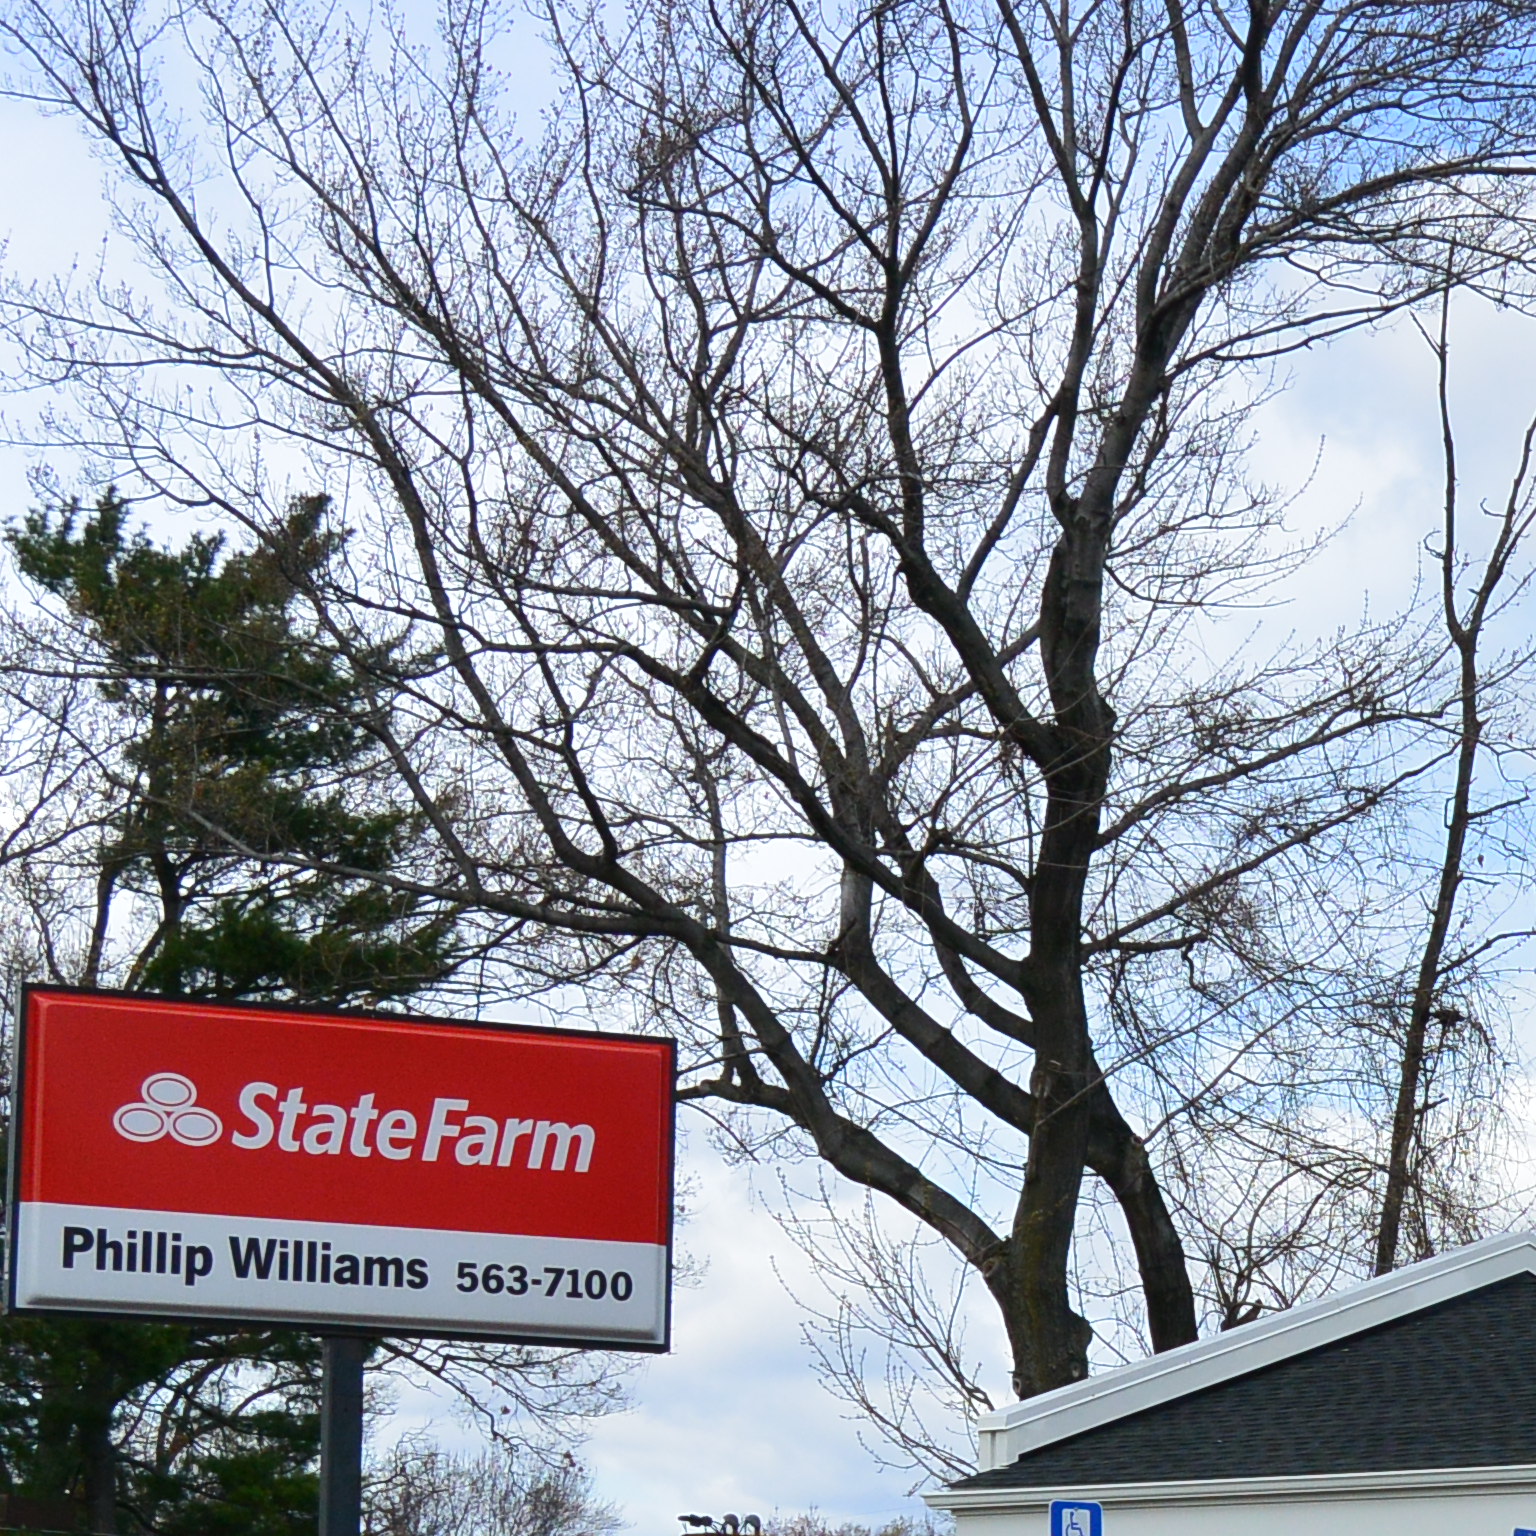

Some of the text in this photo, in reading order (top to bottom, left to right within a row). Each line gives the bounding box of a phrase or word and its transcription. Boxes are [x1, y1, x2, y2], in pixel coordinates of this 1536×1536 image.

[62, 1226, 633, 1301] Phillip Williams 563-7100
